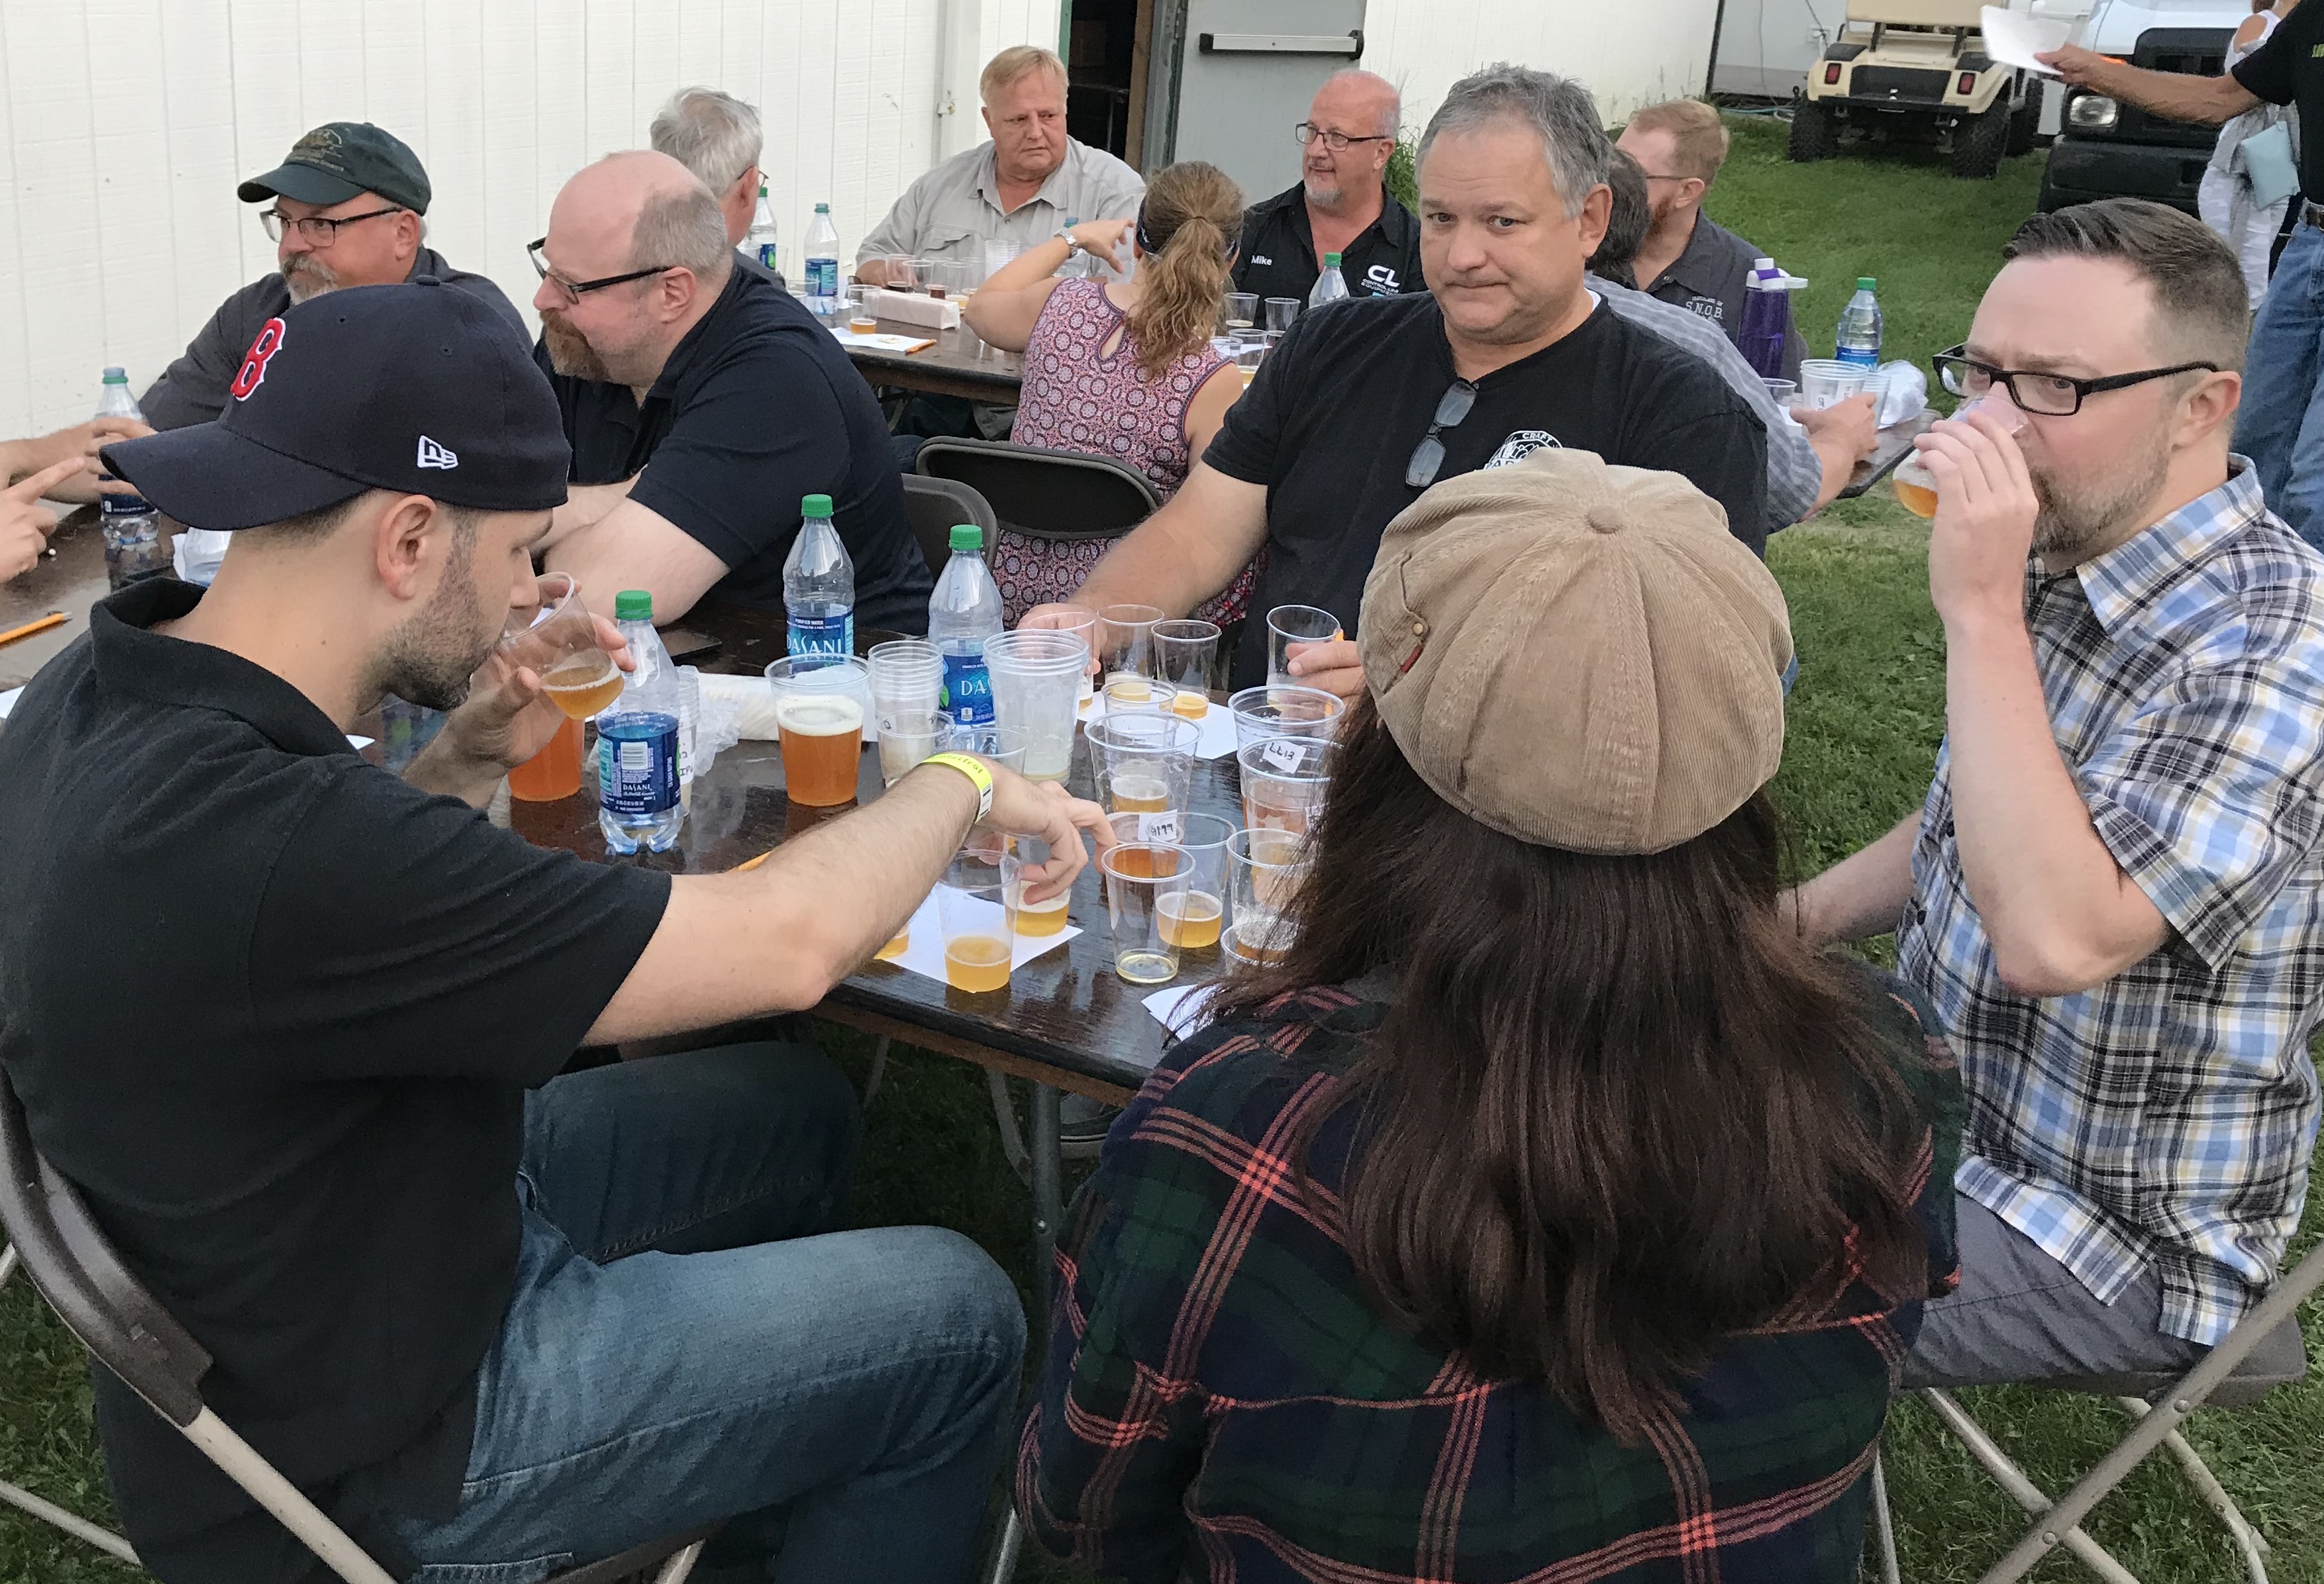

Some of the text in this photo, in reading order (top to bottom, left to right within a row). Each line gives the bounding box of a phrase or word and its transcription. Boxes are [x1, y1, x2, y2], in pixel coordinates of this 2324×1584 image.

[1251, 255, 1272, 266] Mike
[1368, 265, 1400, 287] CL
[230, 318, 286, 401] B
[1523, 432, 1553, 444] CRAFT
[787, 634, 842, 657] DASANI
